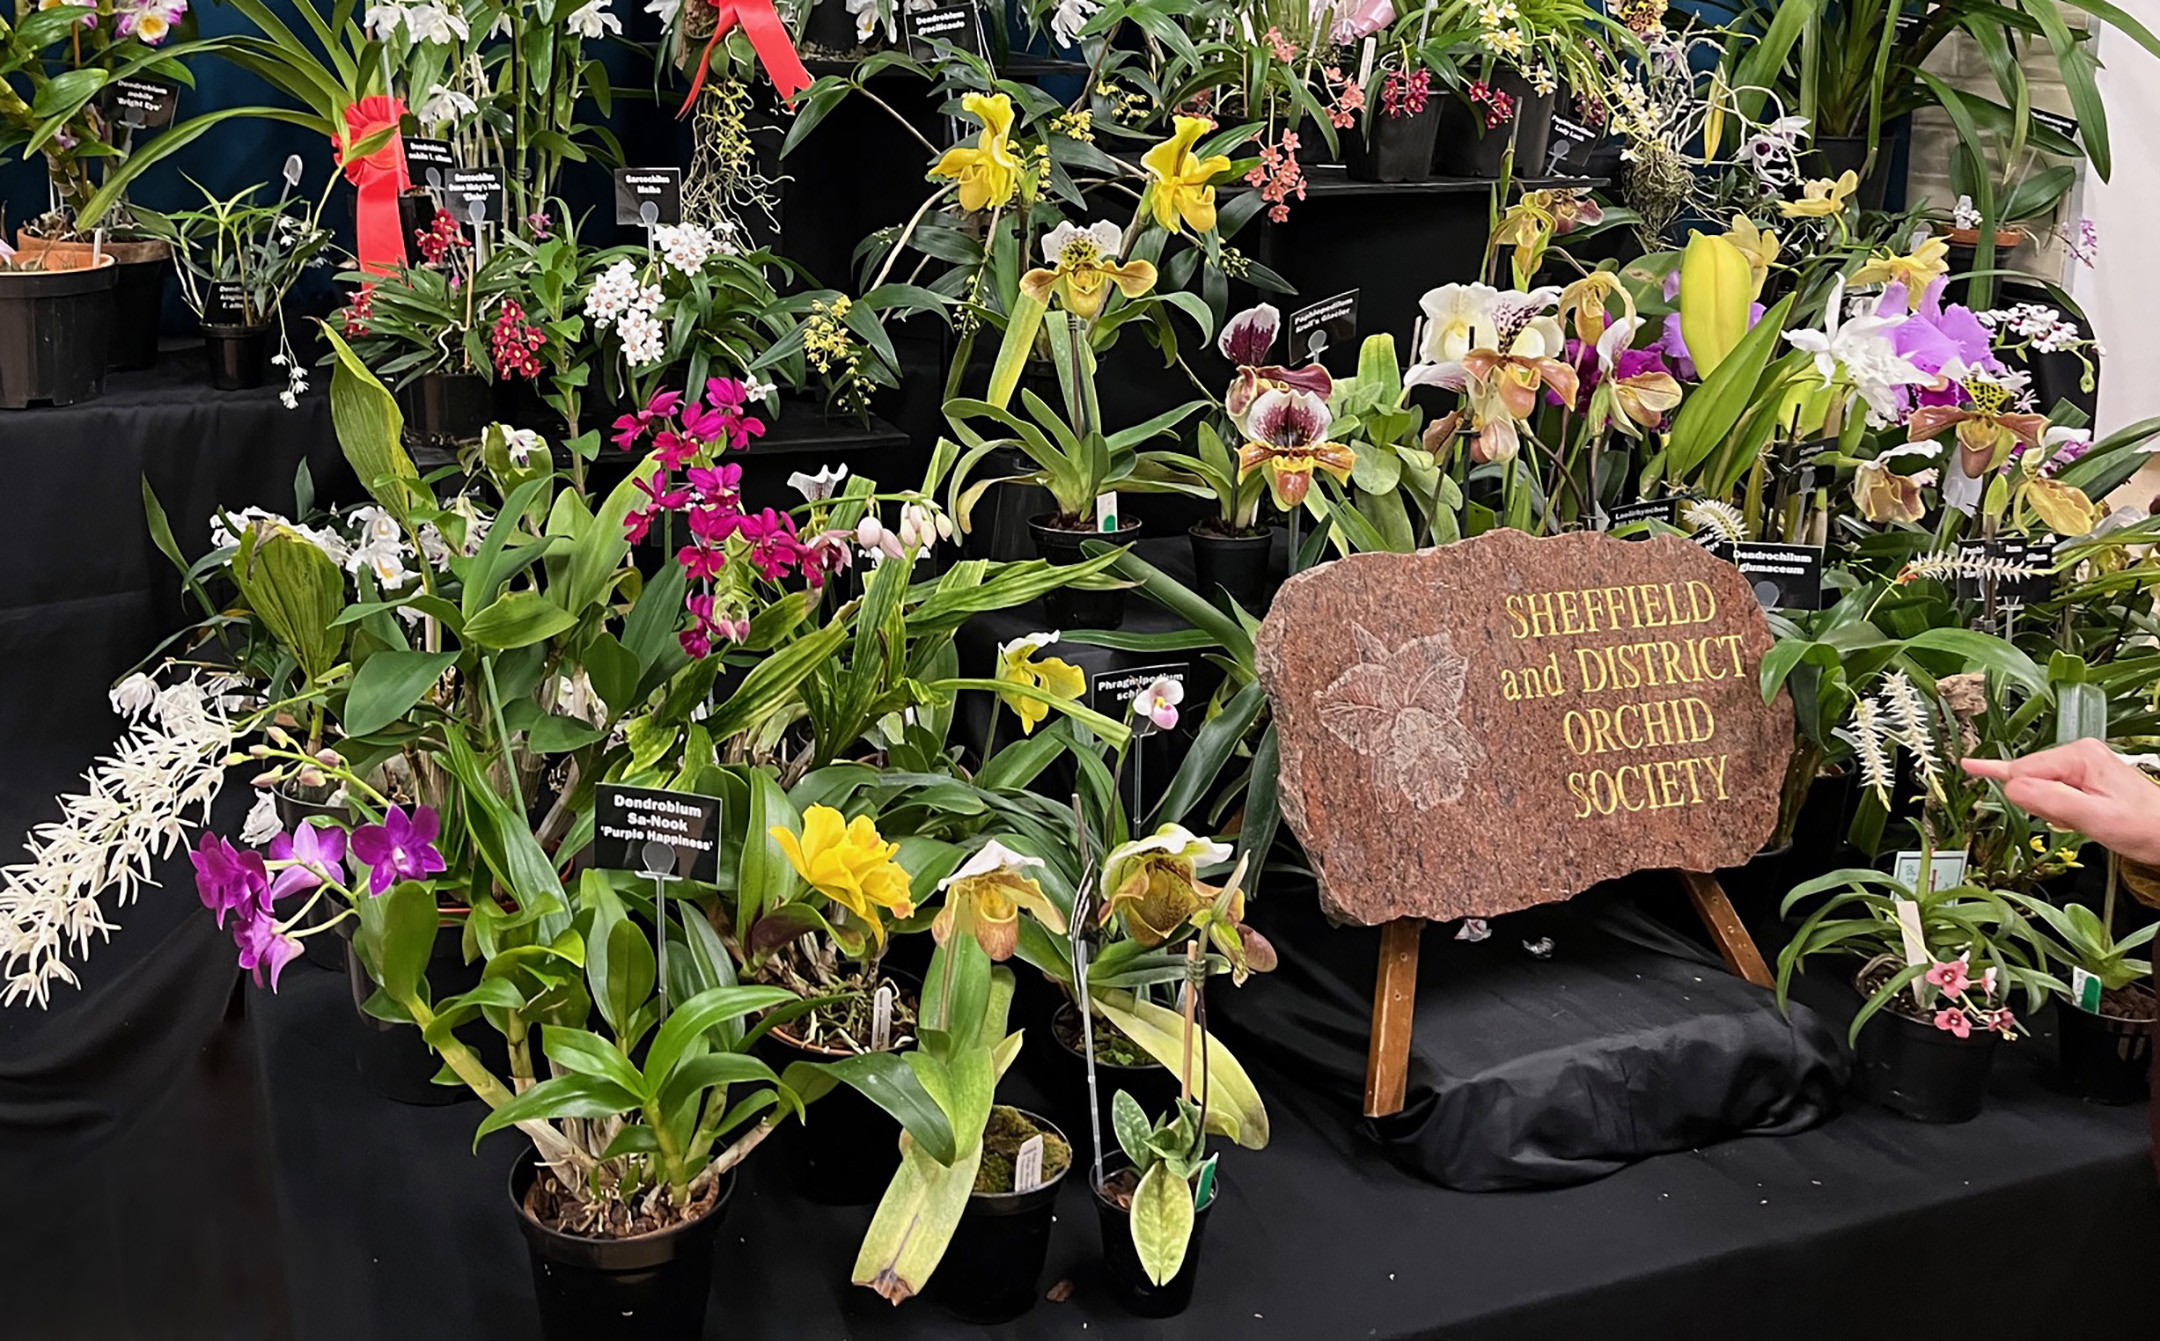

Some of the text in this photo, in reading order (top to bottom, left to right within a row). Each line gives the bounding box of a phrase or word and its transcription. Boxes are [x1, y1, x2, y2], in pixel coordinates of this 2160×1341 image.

[1733, 549, 1813, 564] Dendrochilum
[1505, 580, 1716, 639] SHEFFIELD
[1500, 635, 1747, 701] and DISTRICT
[1562, 697, 1715, 755] ORCHID
[613, 793, 703, 819] Dendrobium
[1567, 754, 1730, 818] SOCIETY
[600, 825, 714, 852] 'Purple Happiness'
[627, 811, 689, 832] Sa-Nook
